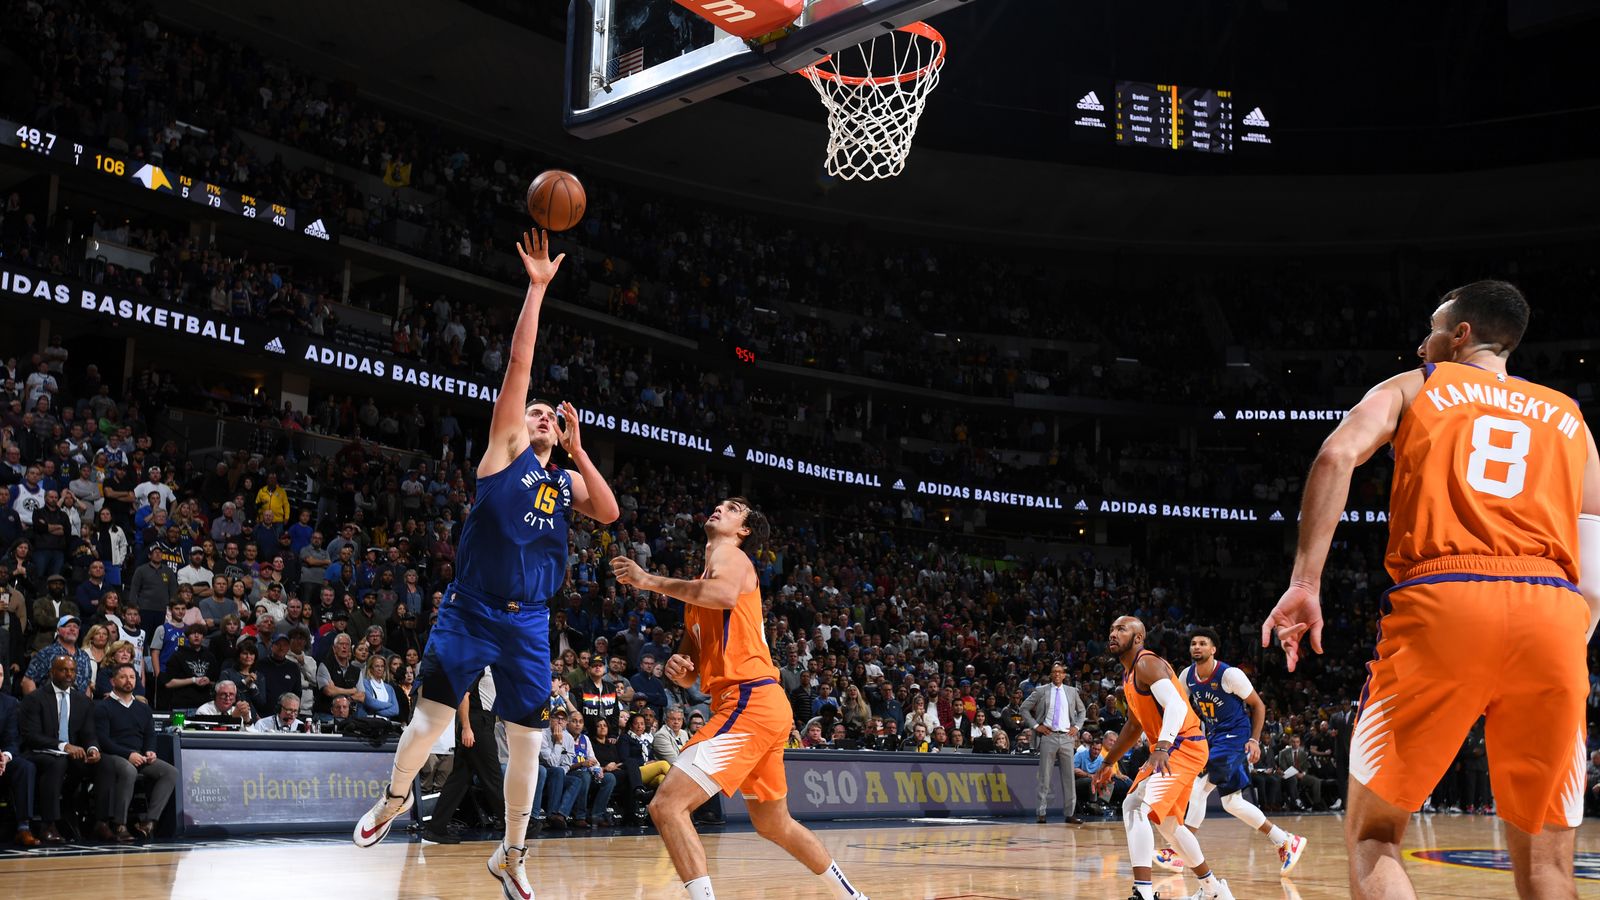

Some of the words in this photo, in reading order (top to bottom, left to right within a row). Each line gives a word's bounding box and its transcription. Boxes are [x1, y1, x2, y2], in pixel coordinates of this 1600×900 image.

[1076, 103, 1105, 111] adidas
[1130, 113, 1153, 123] Kaminsky
[1242, 118, 1270, 127] adidas
[16, 125, 57, 150] 49.7
[73, 143, 83, 154] TO
[75, 154, 79, 166] 1
[95, 154, 125, 176] 106
[180, 175, 192, 186] FLS
[181, 187, 189, 198] 5
[206, 184, 221, 195] FT%
[207, 194, 221, 208] 79
[241, 194, 256, 206] 3P%
[243, 205, 256, 218] 26
[272, 215, 285, 227] 40
[304, 227, 330, 240] adidas
[1, 271, 71, 304] IDAS
[81, 290, 246, 345] BASKETBALL
[735, 346, 755, 363] 9:54
[304, 344, 385, 377] ADIDAS
[392, 364, 500, 403] BASKETBAL
[1235, 410, 1286, 420] ADIDAS
[1425, 382, 1559, 423] KAMINSKY
[1557, 412, 1580, 440] III
[621, 418, 713, 453] BASKETBALL
[1466, 414, 1531, 499] 8
[746, 448, 794, 471] ADIDAS
[797, 460, 882, 487] BASKETBALL
[534, 482, 559, 515] 15
[557, 475, 571, 507] HIGH
[917, 481, 971, 499] ADIDAS
[974, 488, 1063, 509] BASKETBALL
[1100, 500, 1157, 515] ADIDAS
[1162, 505, 1258, 521] BASKETBALL
[523, 511, 555, 530] CITY
[1205, 691, 1225, 708] HIGH
[1199, 701, 1215, 717] 27
[191, 786, 221, 797] planet
[243, 773, 320, 806] planet
[328, 772, 392, 800] fitnes
[803, 768, 858, 808] $10
[865, 771, 889, 804] A
[894, 771, 1012, 804] MONTH
